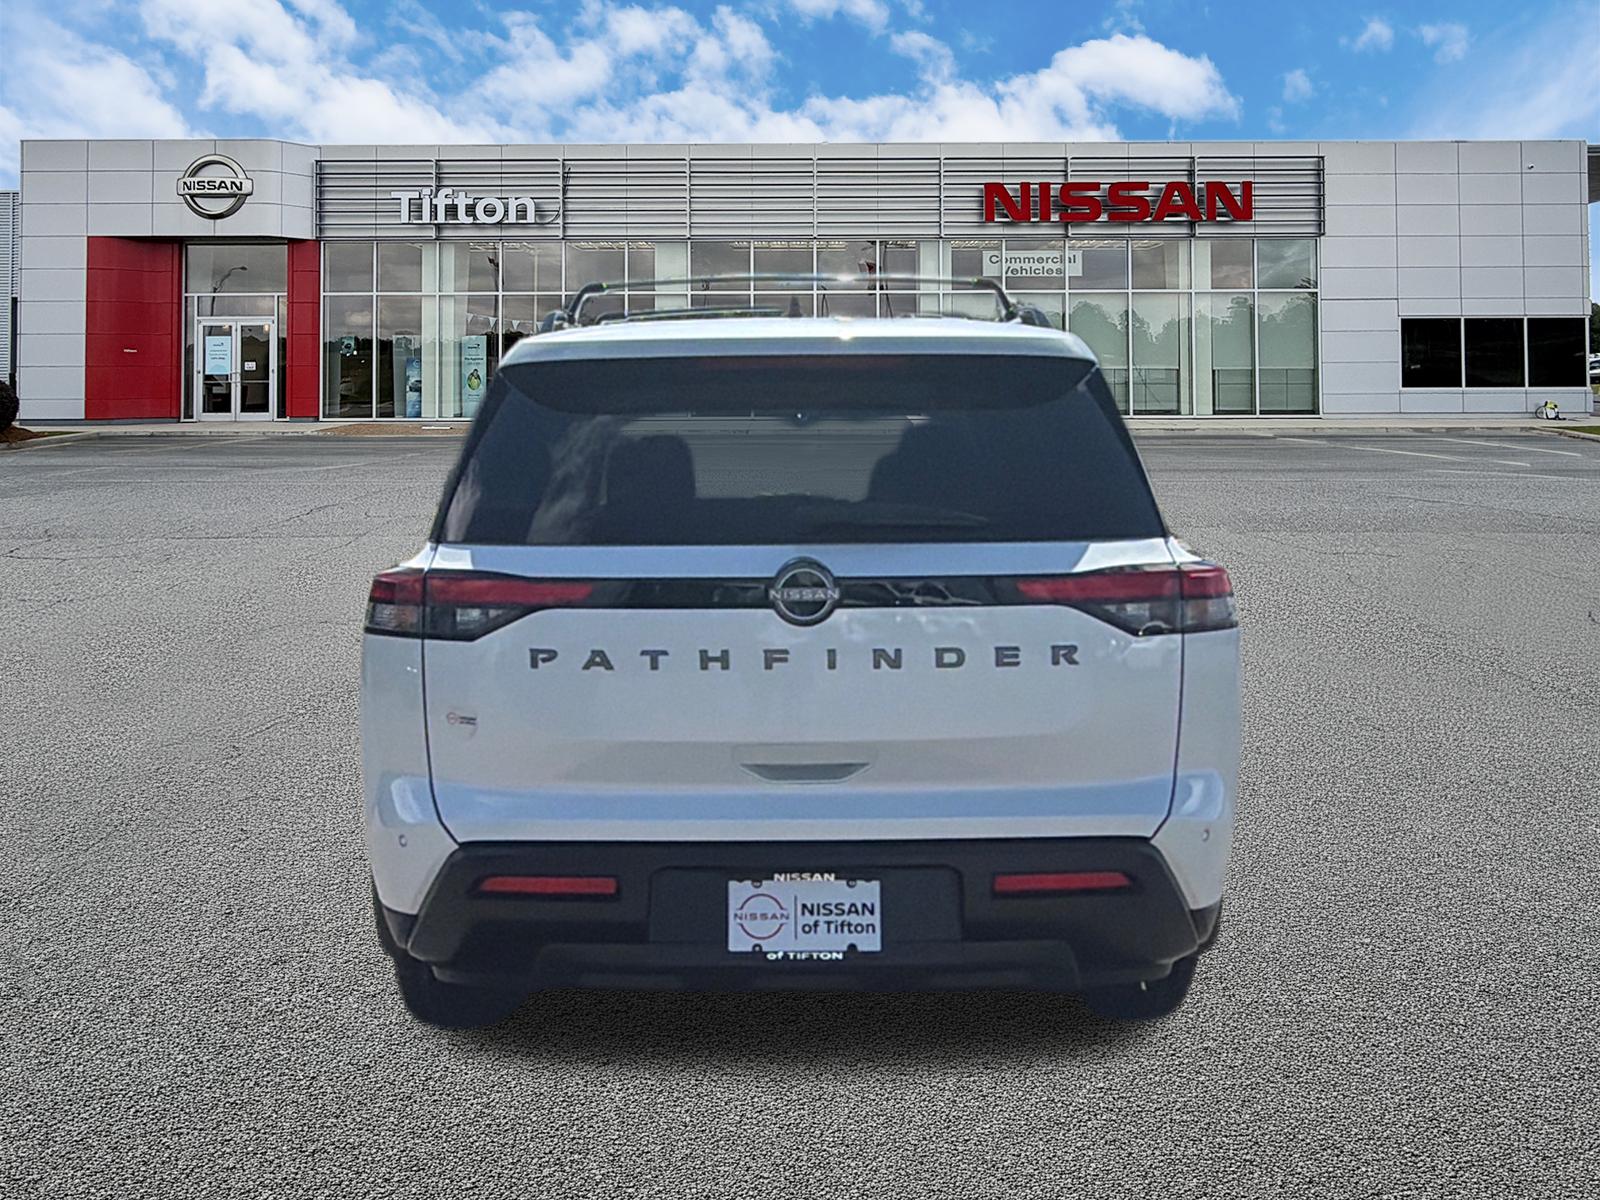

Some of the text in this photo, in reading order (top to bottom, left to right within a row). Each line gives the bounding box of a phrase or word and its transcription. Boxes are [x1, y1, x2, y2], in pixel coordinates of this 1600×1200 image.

[182, 180, 243, 191] NISSAN
[391, 188, 536, 224] Tifton
[984, 181, 1254, 222] NISSAN
[769, 588, 840, 600] NISSAN
[529, 644, 1080, 671] PATHFINDER
[773, 873, 835, 882] NISSAN
[801, 903, 875, 916] NISSAN
[734, 913, 789, 921] NISSAN
[801, 920, 876, 934] of Tifton
[766, 951, 843, 960] of TIFTON
